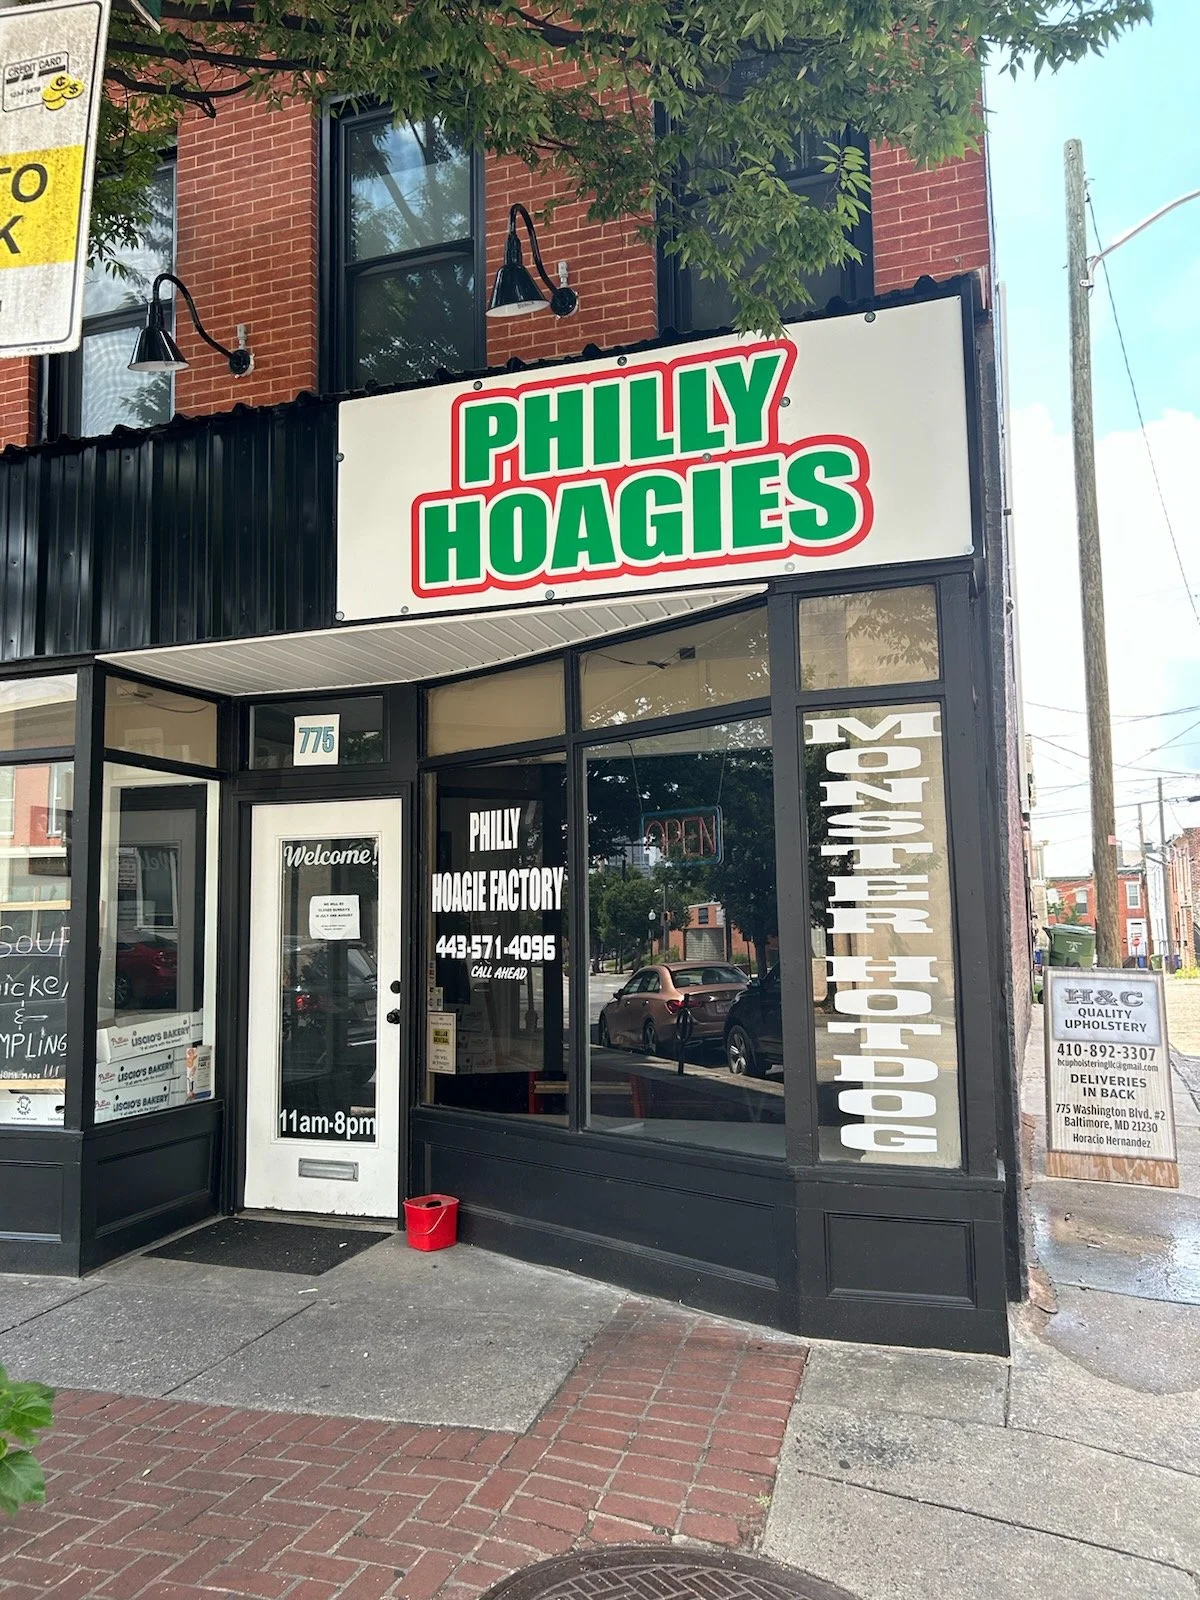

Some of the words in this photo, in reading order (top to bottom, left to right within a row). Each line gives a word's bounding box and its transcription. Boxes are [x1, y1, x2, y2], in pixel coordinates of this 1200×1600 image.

[39, 56, 62, 69] CARD
[463, 354, 788, 485] PHILLY
[423, 449, 859, 585] HOAGIES
[298, 727, 335, 754] 775
[469, 807, 521, 852] PHILLY
[804, 711, 942, 934] MONSTER
[646, 814, 716, 857] OPEN
[283, 844, 379, 868] Welcome!
[431, 870, 487, 913] HOAGIE
[489, 866, 564, 912] FACTORY
[435, 935, 556, 961] 443-571-4096
[471, 964, 493, 979] CALL
[494, 967, 528, 980] AHEAD
[1064, 987, 1144, 1007] H&C
[1078, 1008, 1132, 1019] QUALITY
[163, 1026, 190, 1040] BAKERY
[1065, 1020, 1147, 1032] UPHOLSTERY
[1057, 1043, 1156, 1061] 410-892-3307
[118, 1068, 147, 1082] LISCIO'S
[148, 1061, 175, 1074] BAKERY
[1057, 1058, 1159, 1072] hcupholsteringllc@gmail.com
[1070, 1073, 1147, 1088] DELIVERIES
[142, 1094, 169, 1107] BAKERY
[1083, 1087, 1096, 1097] IN
[1100, 1088, 1135, 1100] BACK
[1056, 1103, 1071, 1114] 775
[1073, 1104, 1126, 1118] Washington
[1129, 1107, 1152, 1120] Blvd.
[1154, 1110, 1165, 1120] #2
[278, 1108, 377, 1140] 11am-8pm
[1064, 1116, 1112, 1130] Baltimore,
[1115, 1120, 1129, 1131] MD
[1131, 1121, 1158, 1133] 21230
[1073, 1133, 1104, 1145] Horacio
[1106, 1135, 1151, 1148] Hernandez
